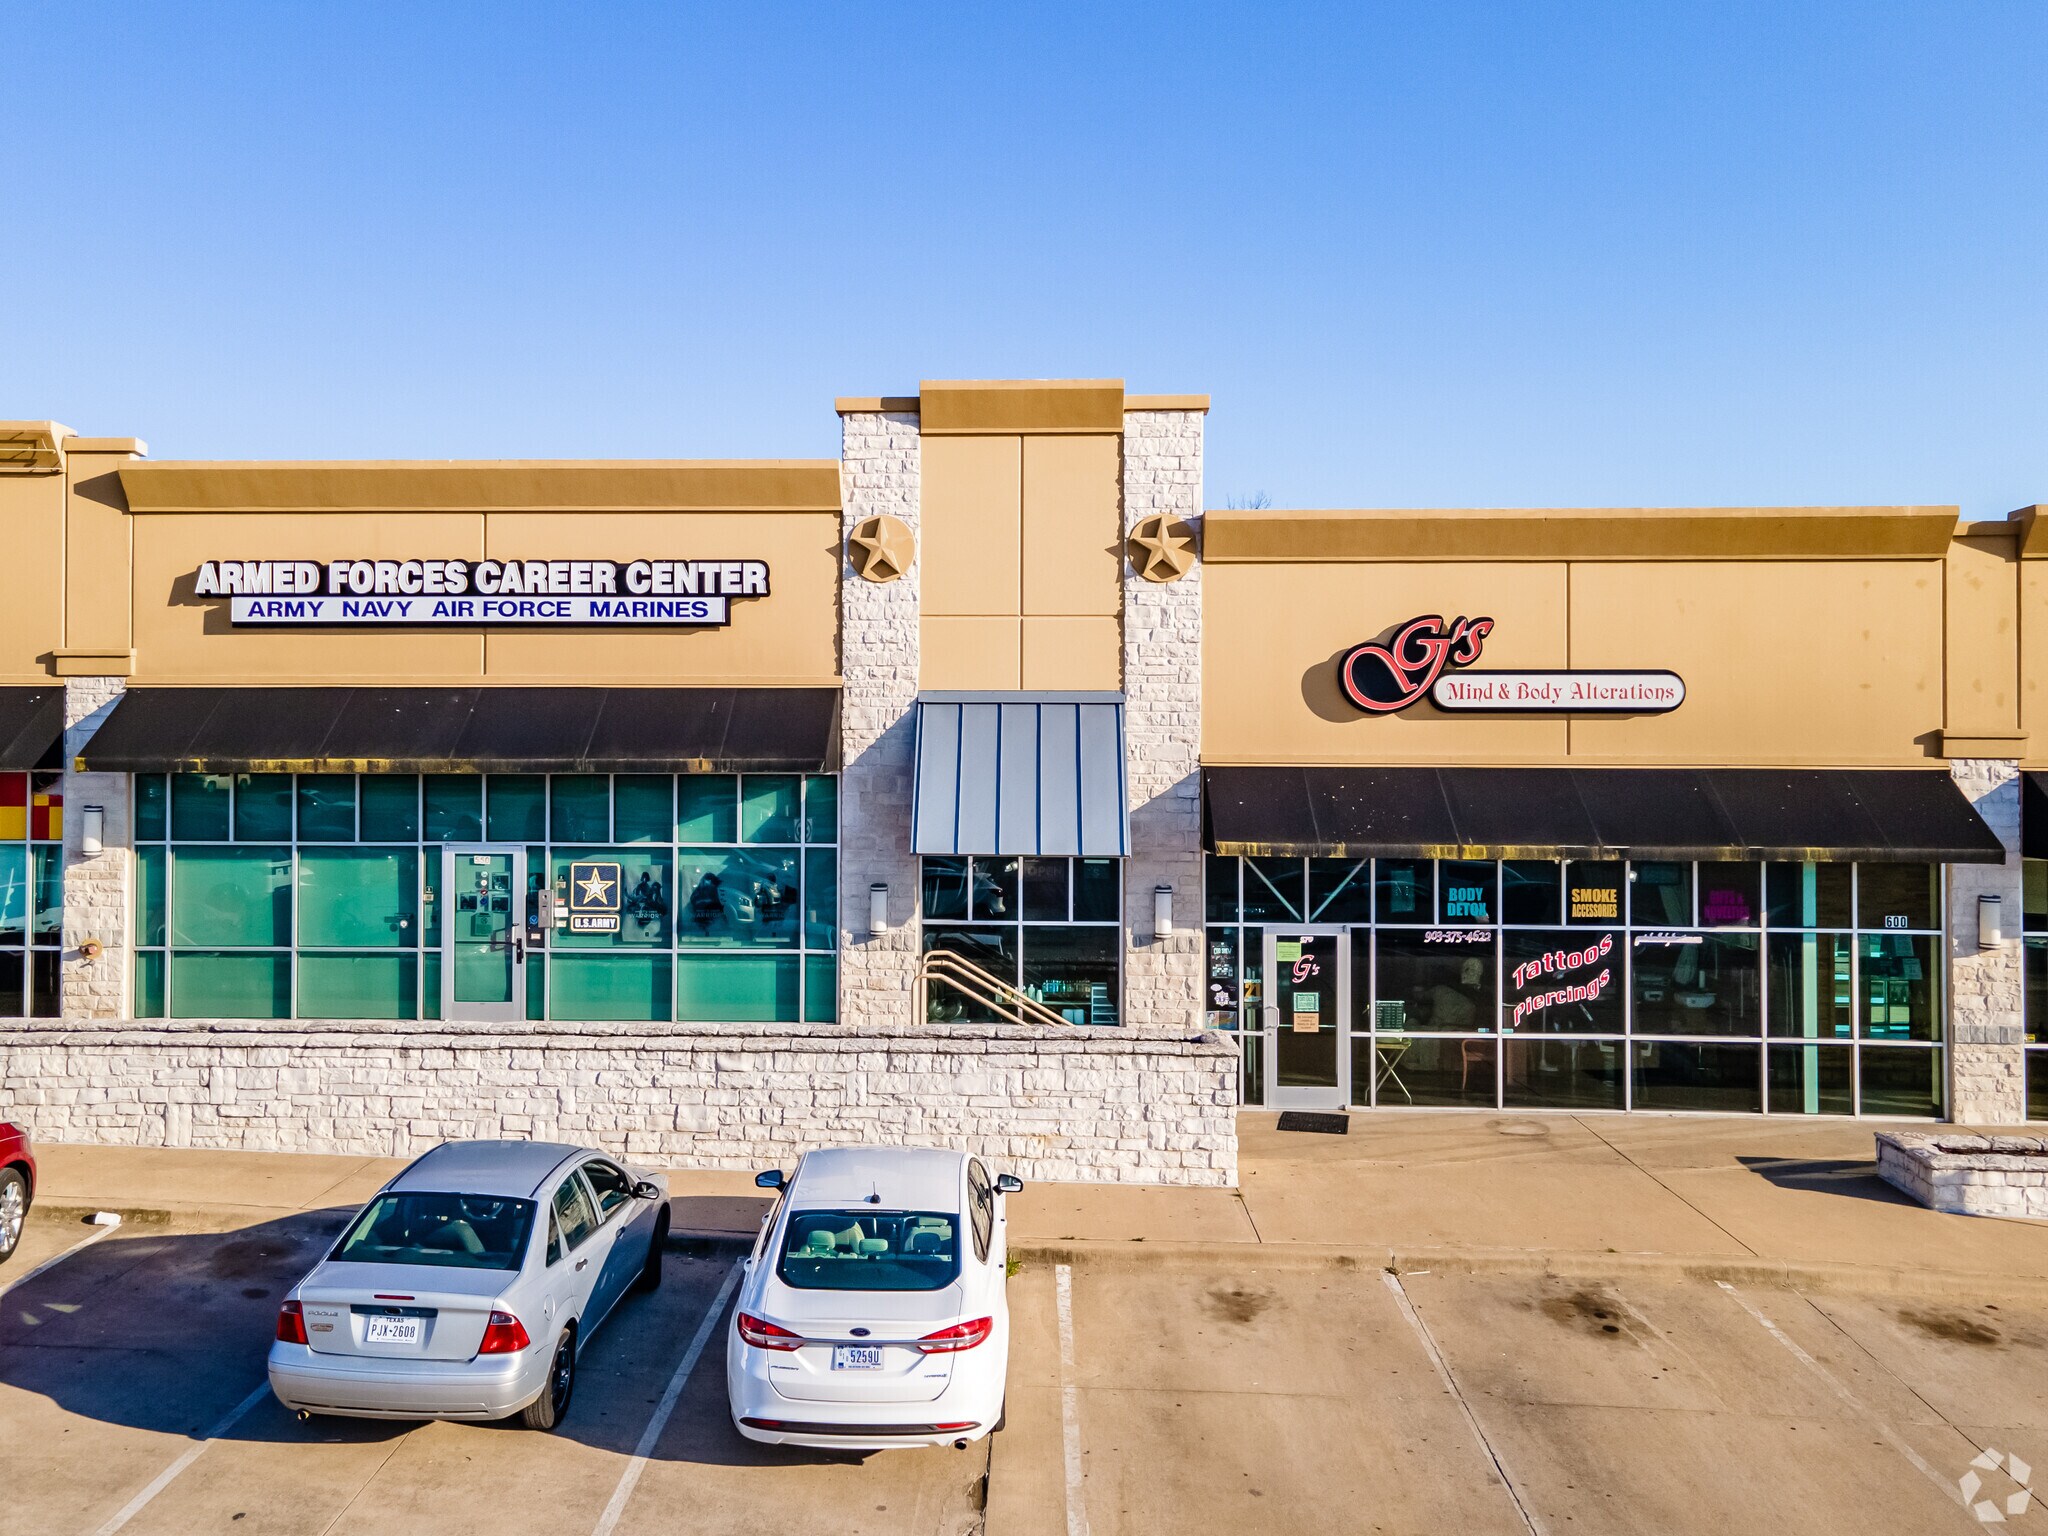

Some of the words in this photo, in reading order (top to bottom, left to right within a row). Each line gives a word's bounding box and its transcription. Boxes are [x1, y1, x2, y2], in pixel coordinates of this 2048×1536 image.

[194, 561, 321, 595] ARMED
[328, 561, 469, 595] FORCES
[475, 561, 617, 595] CAREER
[625, 561, 769, 595] CENTER
[247, 600, 325, 618] ARMY
[341, 600, 414, 618] NAVY
[431, 600, 475, 618] AIR
[482, 600, 572, 618] FORCE
[589, 600, 709, 619] MARINES
[1446, 681, 1494, 703] Mind
[1497, 684, 1511, 701] &
[1516, 681, 1563, 704] Body
[1570, 681, 1676, 703] Alterations
[1448, 887, 1484, 902] BODY
[1571, 888, 1617, 903] SMOKE
[1447, 902, 1487, 917] DETOX
[1571, 903, 1618, 918] ACCESSORIES
[1886, 916, 1907, 927] 600
[1423, 930, 1492, 944] 903-375-4622
[1512, 933, 1613, 990] Tattoos
[1513, 968, 1610, 1027] Piercings
[850, 1349, 880, 1364] 5259U
